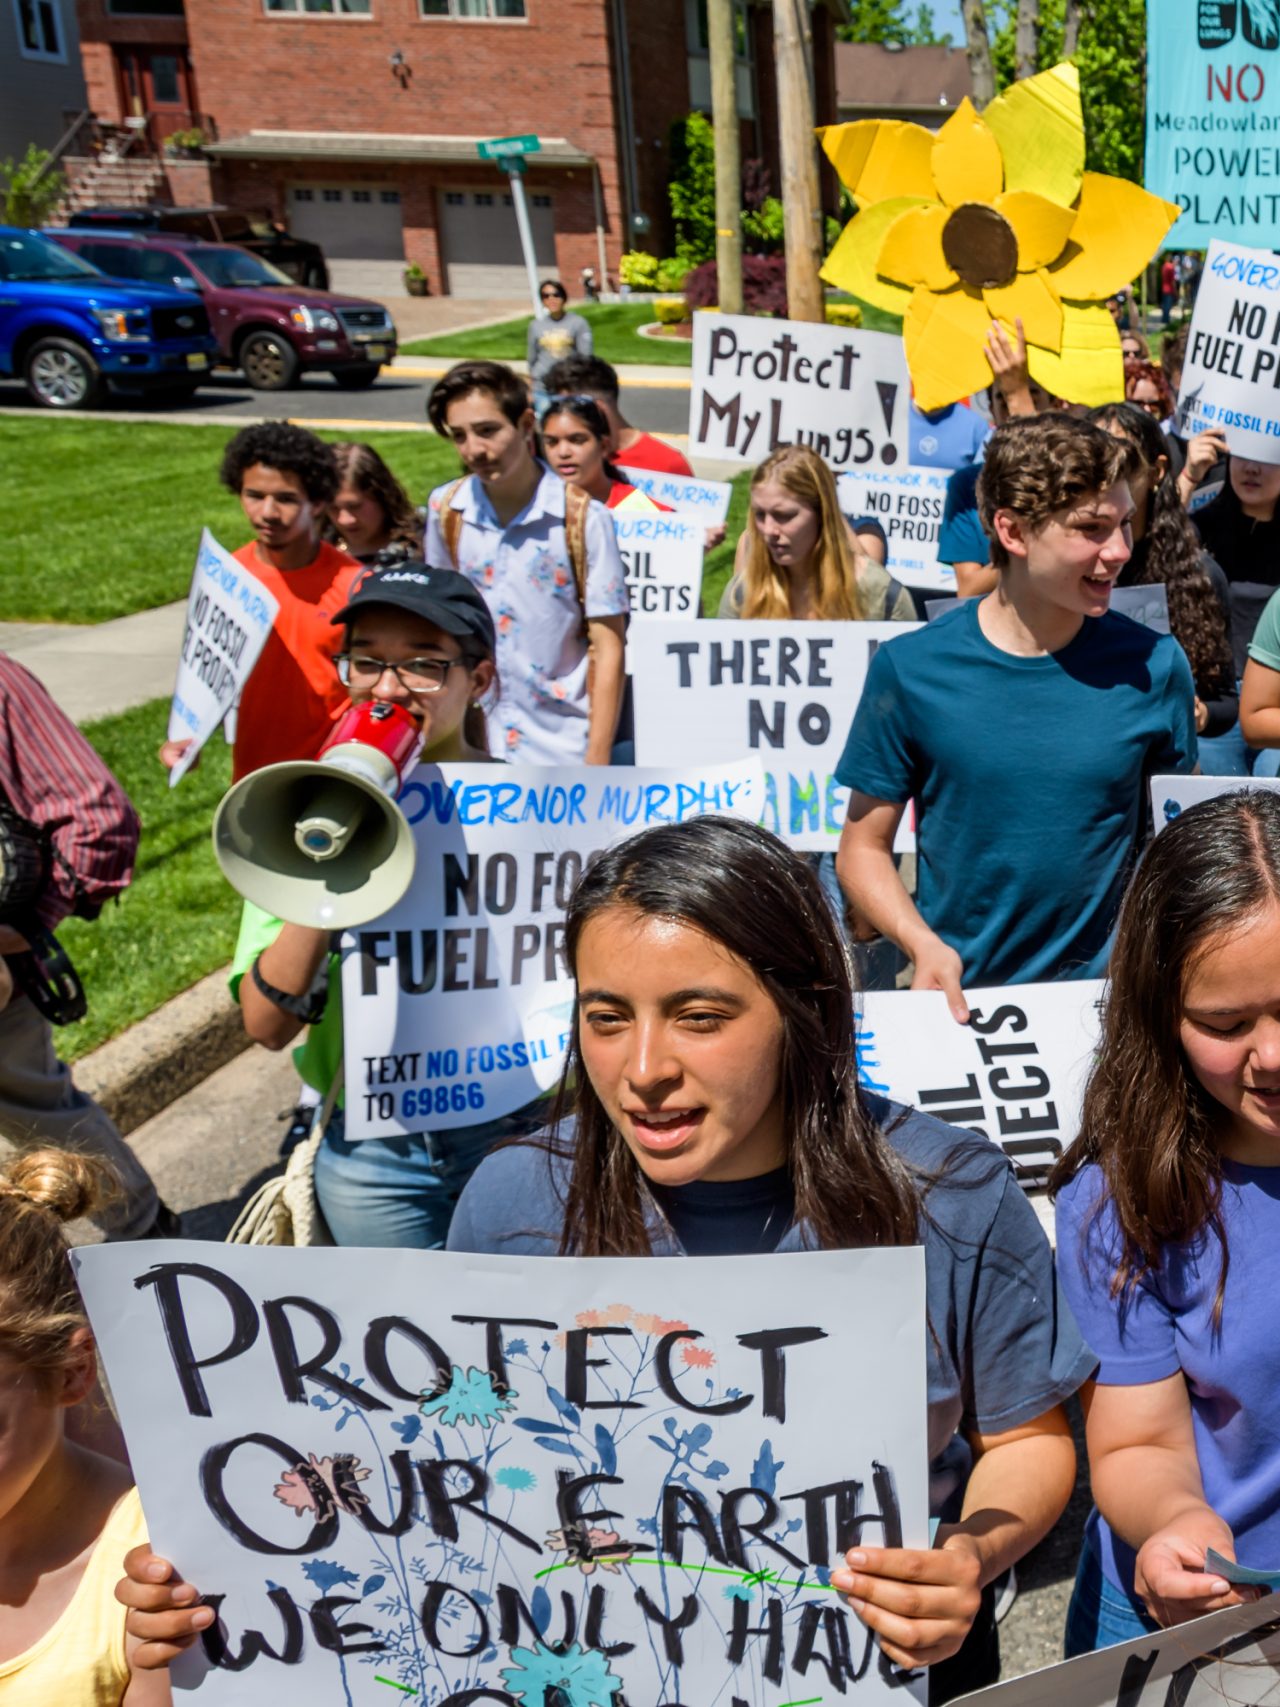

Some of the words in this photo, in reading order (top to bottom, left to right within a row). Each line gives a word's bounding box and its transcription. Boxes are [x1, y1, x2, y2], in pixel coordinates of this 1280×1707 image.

[1207, 63, 1265, 103] NO
[1227, 299, 1268, 340] NO
[708, 327, 861, 390] Protect
[1190, 331, 1244, 379] FUEL
[697, 388, 761, 456] My
[1217, 408, 1262, 433] FOSSIL
[866, 491, 891, 513] NO
[897, 495, 942, 519] FOSS
[889, 519, 938, 542] PROJ
[628, 584, 691, 612] ECTS
[206, 605, 248, 670] FOSSIL
[666, 637, 833, 688] THERE
[749, 699, 831, 749] NO
[400, 780, 587, 827] OVERNOR
[599, 778, 751, 825] MURPHY:
[443, 852, 518, 917] NO
[360, 927, 499, 996] FUEL
[362, 1053, 421, 1085] TEXT
[426, 1049, 459, 1079] NO
[465, 1038, 553, 1074] FOSSIL
[362, 1092, 395, 1122] TO
[401, 1081, 486, 1118] 69866
[969, 1004, 1064, 1178] JECTS
[134, 1262, 829, 1424] PROTECT
[198, 1432, 542, 1555] OUR
[555, 1460, 904, 1572] EARTH
[198, 1586, 390, 1672] WE
[423, 1581, 700, 1668] ONLY
